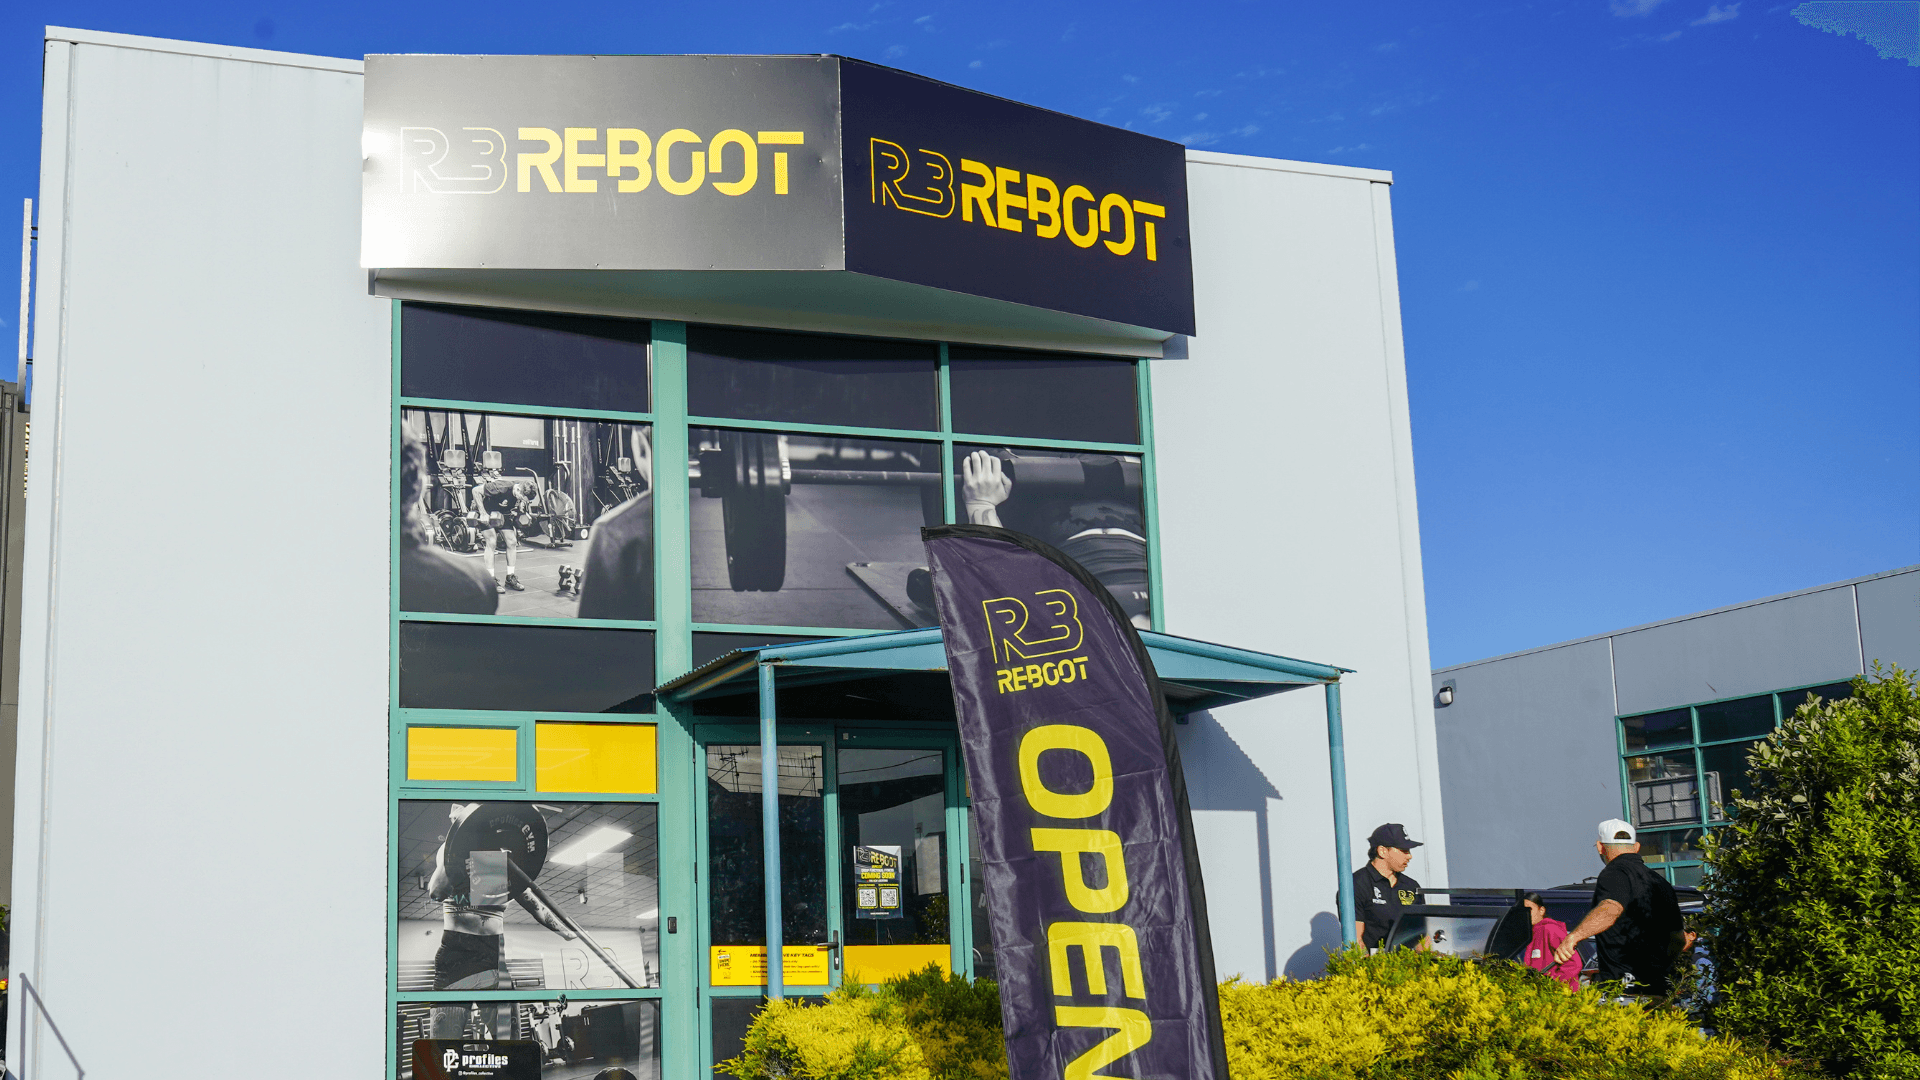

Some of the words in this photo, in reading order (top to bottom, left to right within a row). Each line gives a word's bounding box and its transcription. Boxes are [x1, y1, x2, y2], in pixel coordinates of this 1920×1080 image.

[400, 126, 507, 195] R3
[517, 127, 804, 196] REBOOT
[869, 137, 954, 217] R3
[961, 158, 1165, 262] REBOOT
[982, 589, 1084, 664] R3
[996, 656, 1088, 694] REBOOT
[521, 824, 536, 853] GYM
[870, 852, 897, 867] REBOOT
[1018, 724, 1152, 1080] OPEN
[462, 1054, 508, 1066] profiles
